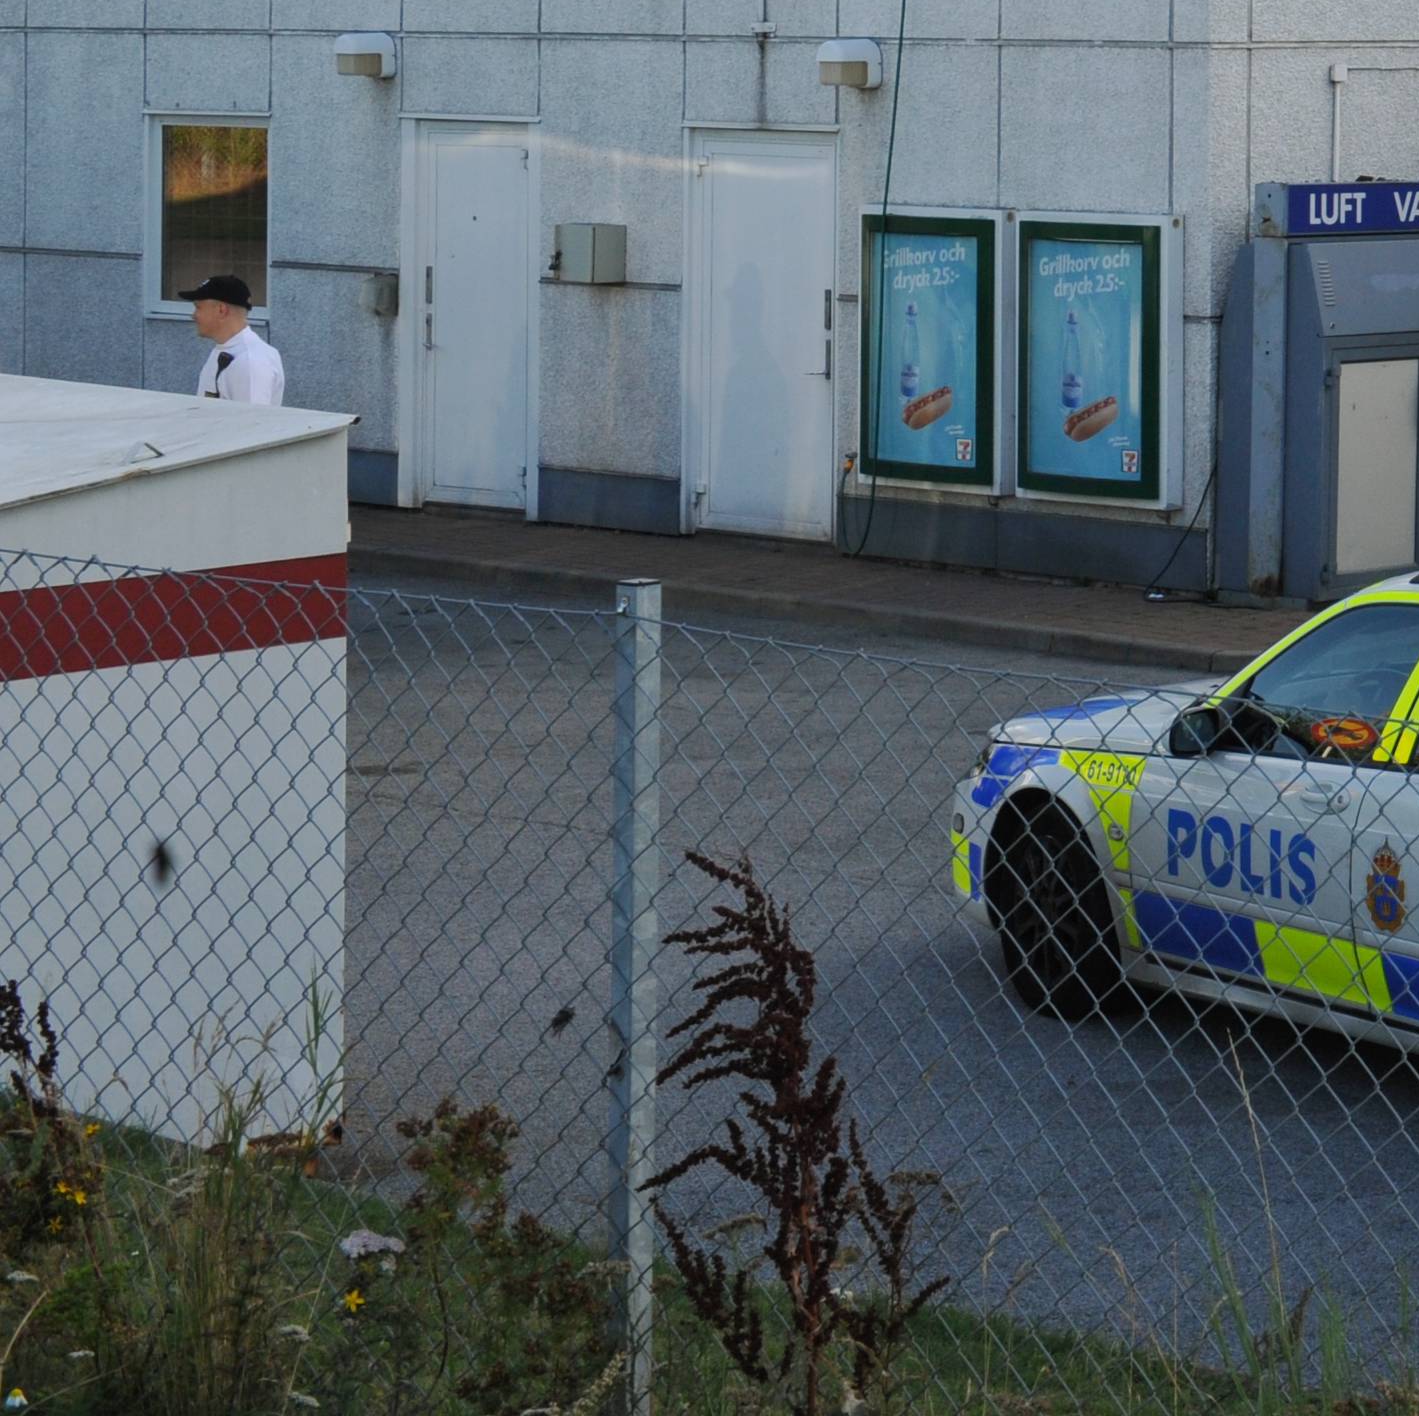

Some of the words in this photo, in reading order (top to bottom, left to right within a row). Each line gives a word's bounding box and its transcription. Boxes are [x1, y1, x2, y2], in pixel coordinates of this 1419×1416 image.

[1309, 192, 1366, 225] LUFT
[939, 243, 965, 262] och
[1039, 253, 1099, 276] Grillkorv
[1102, 248, 1131, 269] och
[893, 268, 931, 293] dryck
[1054, 276, 1094, 302] dryck
[1167, 808, 1316, 906] POLIS
